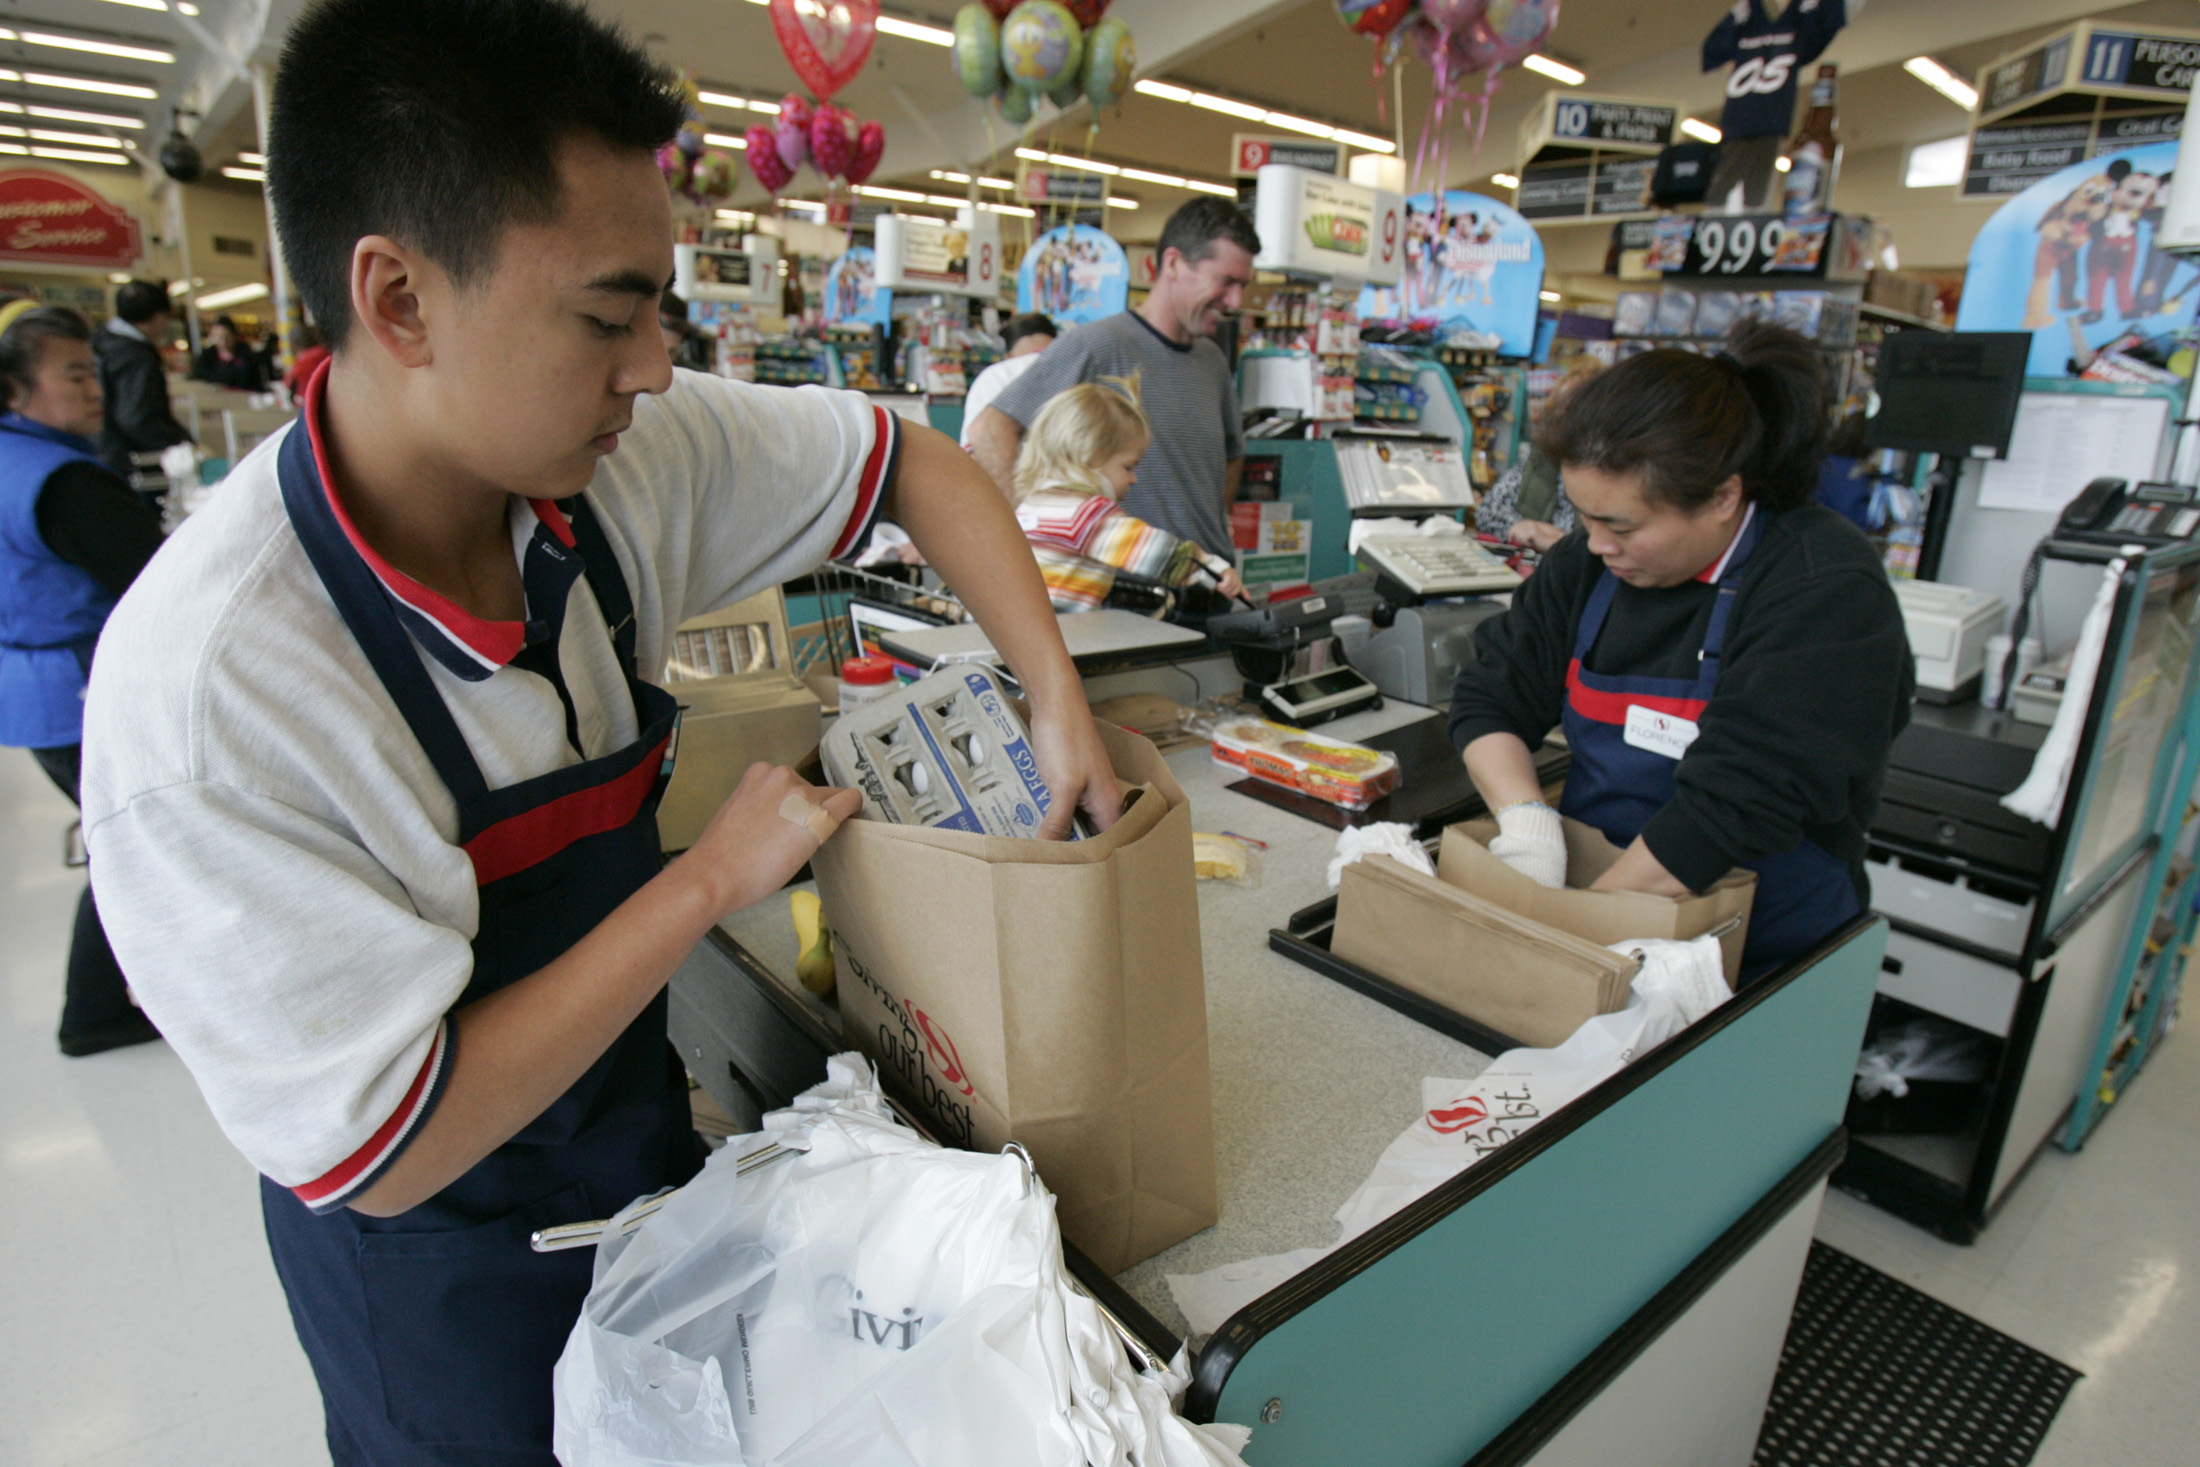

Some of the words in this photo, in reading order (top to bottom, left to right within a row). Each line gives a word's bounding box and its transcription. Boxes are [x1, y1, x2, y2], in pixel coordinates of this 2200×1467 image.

[2089, 38, 2124, 81] 11
[2135, 40, 2200, 66] PERSO
[1556, 103, 1588, 137] 10
[1245, 143, 1263, 168] 9
[1381, 209, 1397, 264] 9
[980, 243, 993, 282] 8
